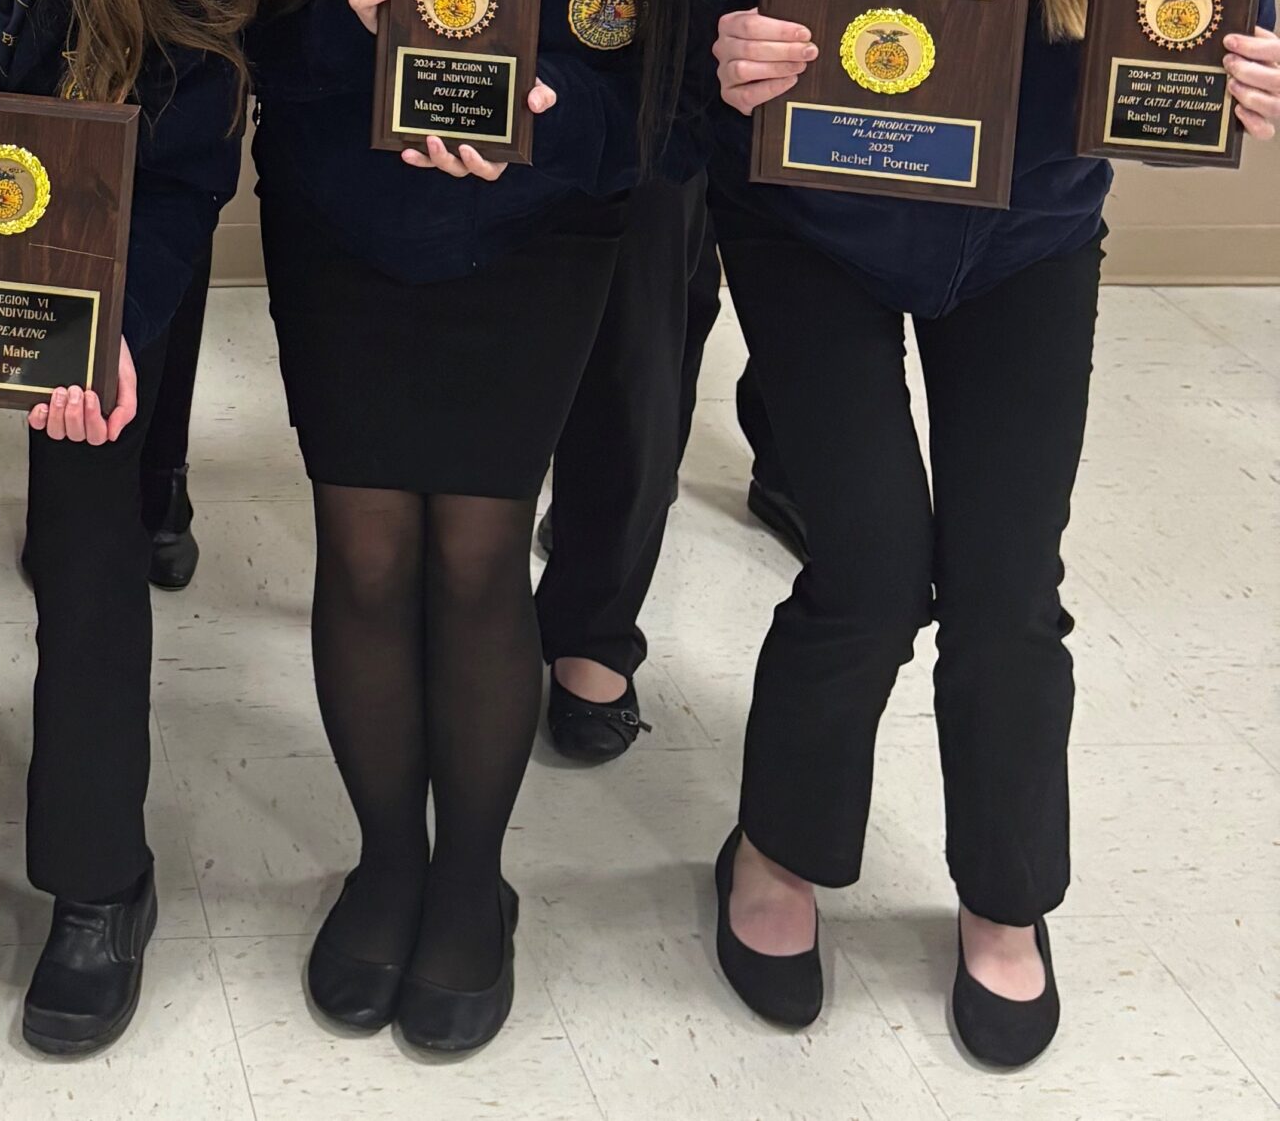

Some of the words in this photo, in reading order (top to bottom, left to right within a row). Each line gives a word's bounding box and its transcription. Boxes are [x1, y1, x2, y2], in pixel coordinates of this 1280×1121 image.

[413, 59, 445, 69] 2024-25
[452, 62, 482, 72] REGION
[488, 65, 497, 73] VI
[418, 71, 436, 80] HIGH
[443, 73, 492, 85] INDIVIDUAL
[1128, 70, 1161, 80] 2024-25
[1167, 73, 1198, 83] REGION
[1205, 76, 1214, 85] VI
[433, 87, 478, 98] POULTRY
[1132, 82, 1151, 92] HIGH
[1158, 84, 1208, 96] INDIVIDUAL
[414, 99, 444, 111] Mateo
[452, 103, 493, 118] Hornsby
[1118, 95, 1141, 105] DAIRY
[1144, 98, 1172, 107] CATTLE
[1175, 100, 1222, 111] EVALUATION
[430, 114, 455, 124] Sleepy
[461, 116, 476, 126] Eye
[832, 116, 867, 126] DAIRY
[872, 120, 936, 133] PRODUCTION
[1128, 110, 1160, 123] Rachel
[1169, 113, 1206, 126] Portner
[853, 129, 913, 142] PLACEMENT
[1142, 124, 1167, 135] Sleepy
[1174, 127, 1188, 136] Eye
[869, 143, 893, 152] 2025
[831, 151, 872, 165] Rachel
[883, 157, 929, 171] Portner
[38, 298, 48, 308] VI
[3, 345, 40, 359] Maher
[2, 364, 21, 375] Eye
